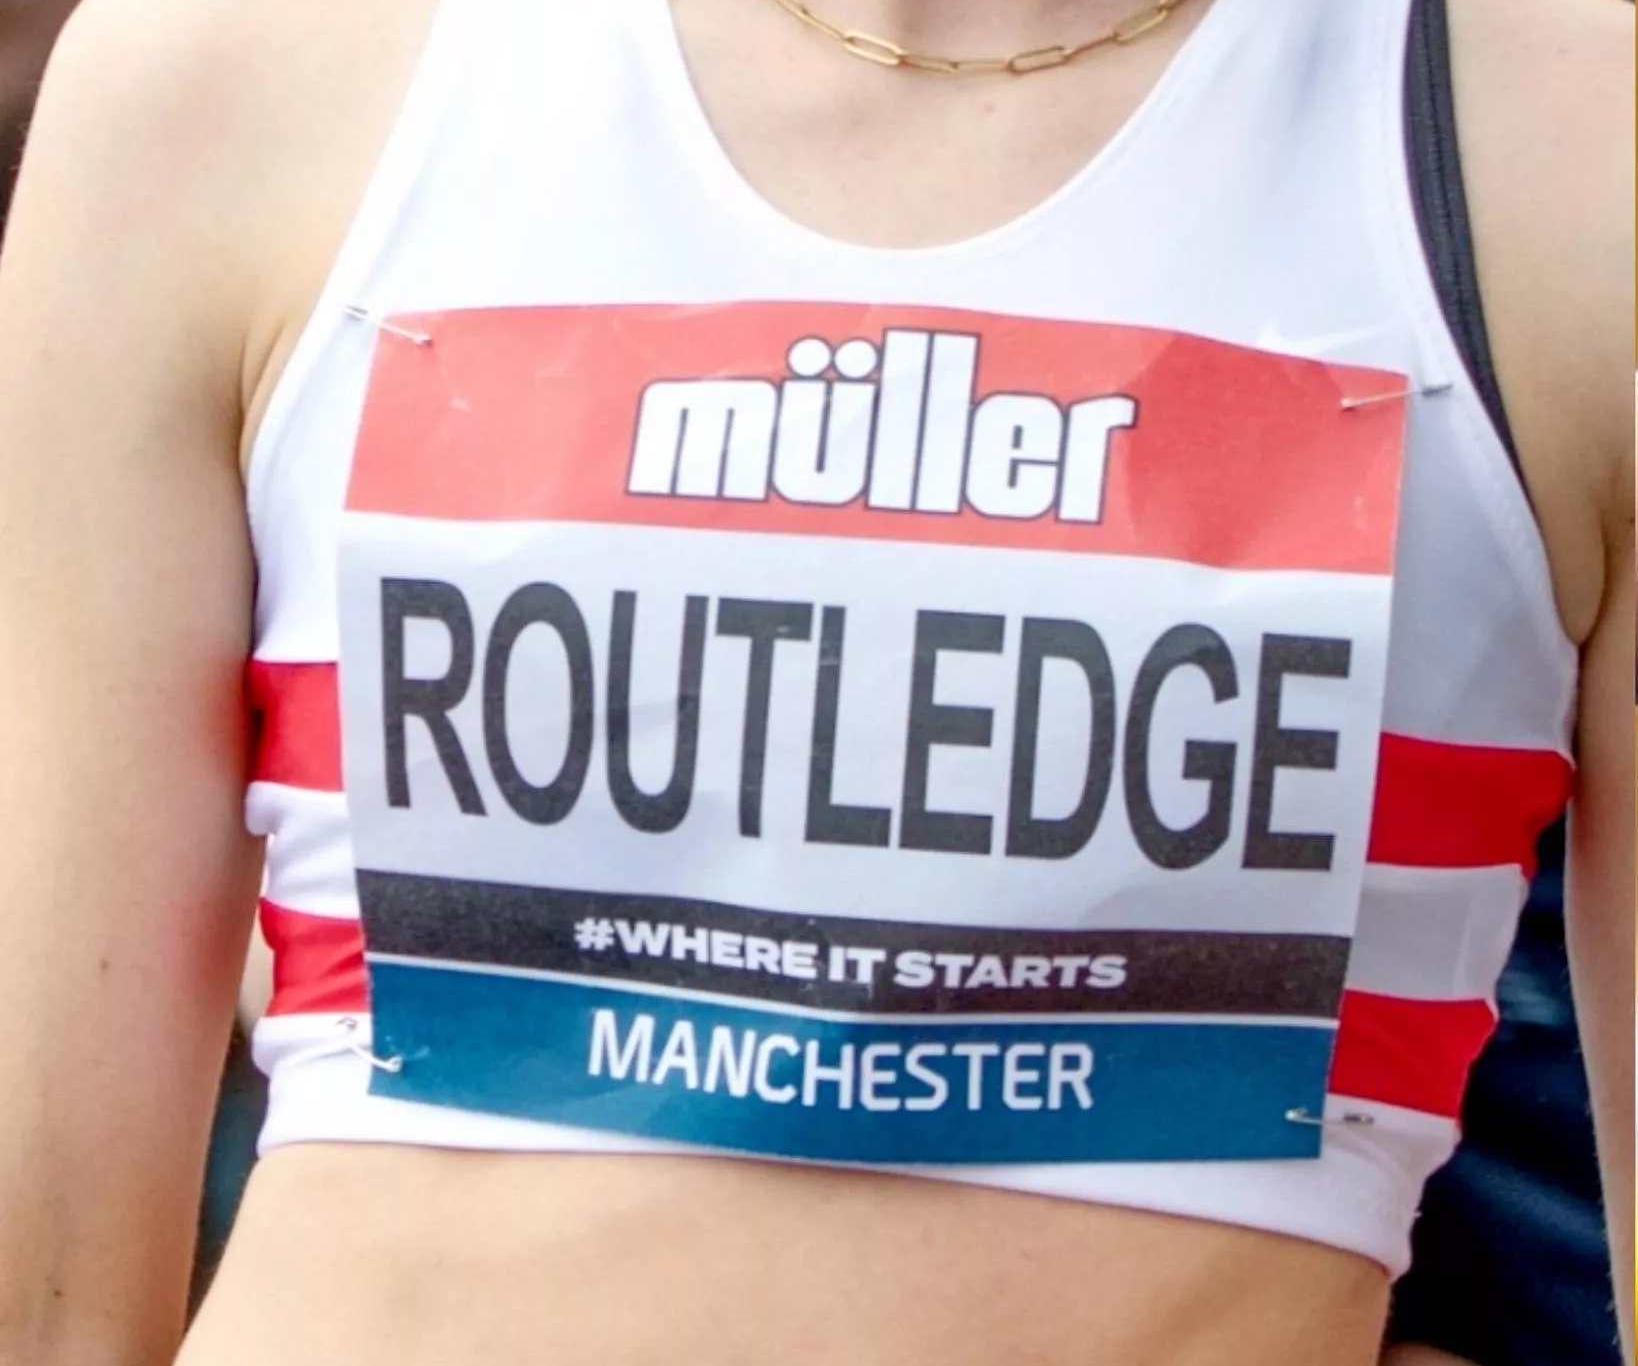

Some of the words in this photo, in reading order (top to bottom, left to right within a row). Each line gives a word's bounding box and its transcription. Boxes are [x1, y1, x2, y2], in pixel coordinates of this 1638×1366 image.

[624, 327, 1140, 524] müller
[378, 575, 1353, 872] ROUTLEDGE
[573, 917, 819, 980] #WHERE
[827, 945, 887, 984] IT
[892, 949, 1128, 990] STARTS
[586, 1007, 1095, 1112] MANCHESTER
